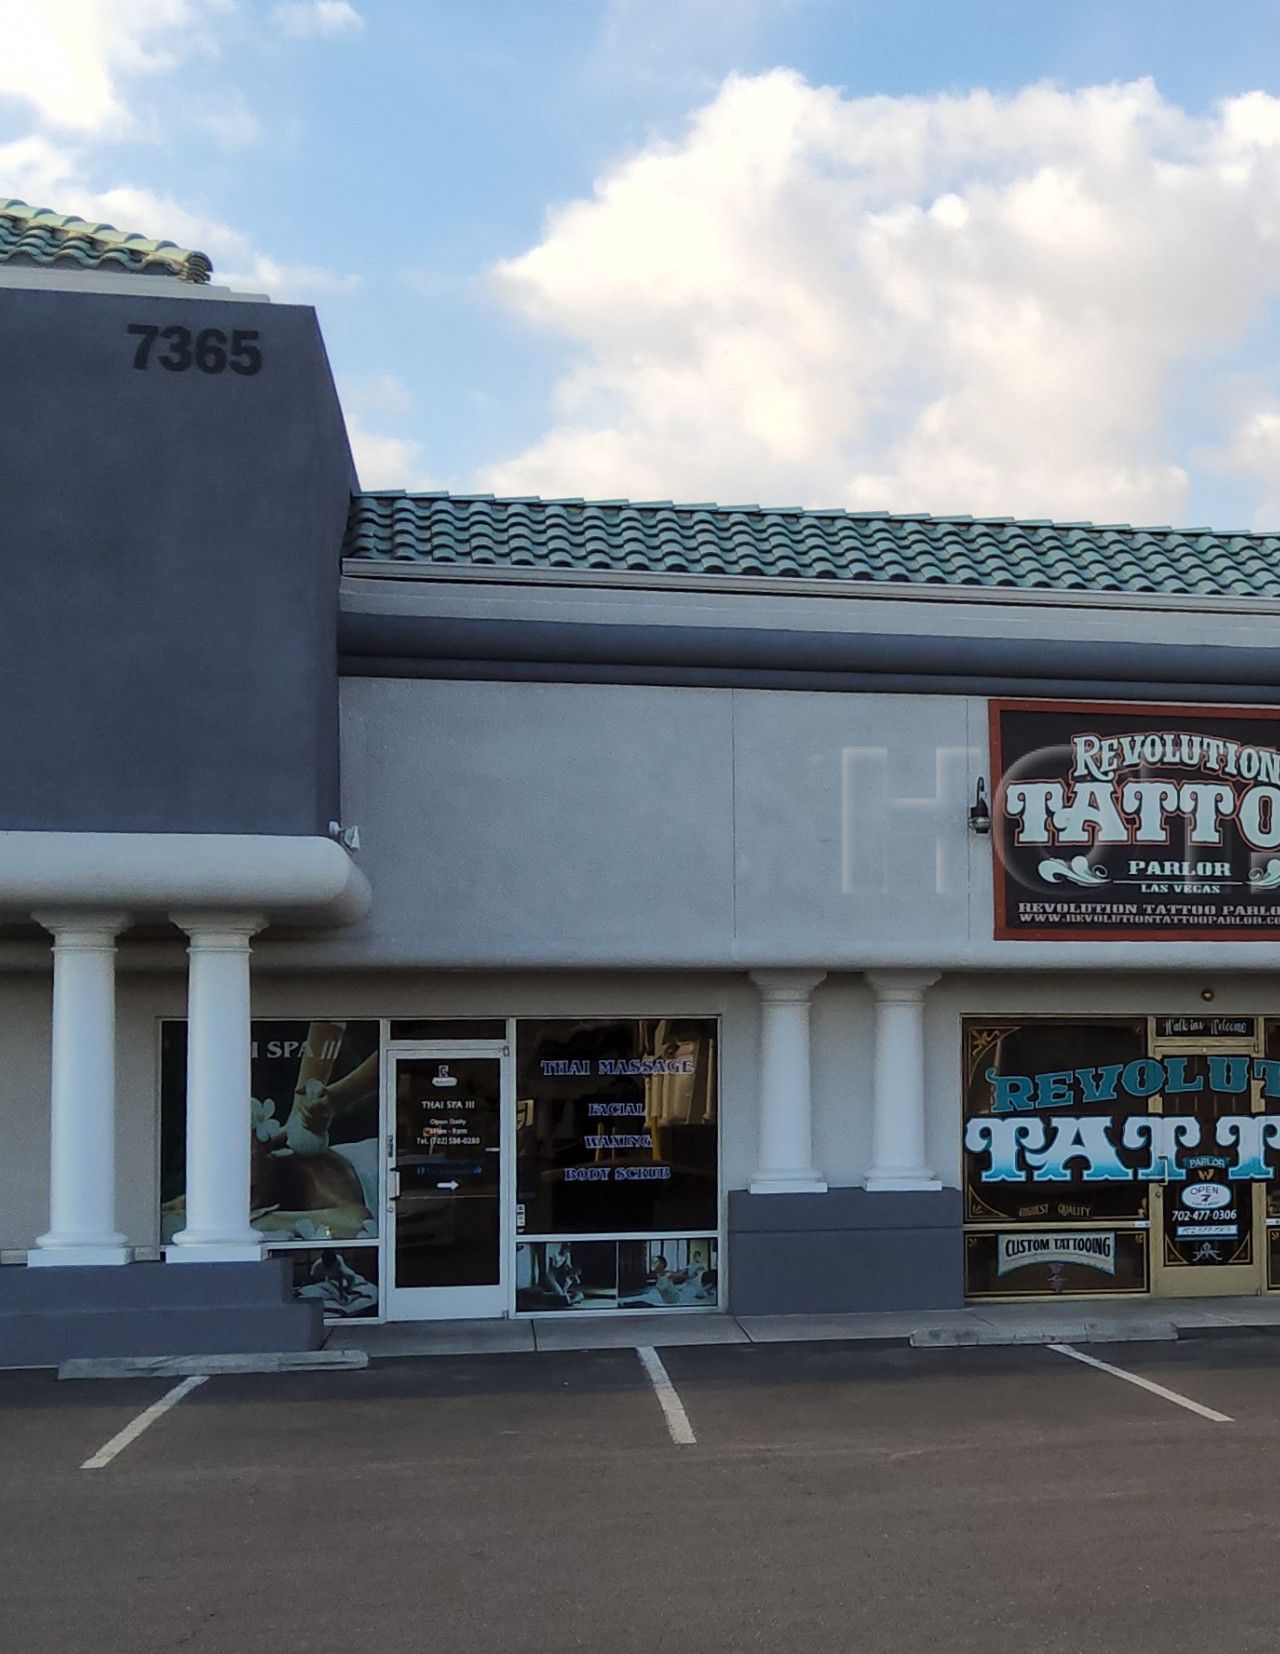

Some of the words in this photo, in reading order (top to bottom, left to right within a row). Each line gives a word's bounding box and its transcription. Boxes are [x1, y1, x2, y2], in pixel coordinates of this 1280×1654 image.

[127, 323, 263, 376] 7365
[1127, 859, 1232, 877] PARLOR
[1141, 884, 1169, 893] LAS
[1174, 883, 1221, 894] VEGAS
[1018, 902, 1138, 914] REVOLUTION
[1143, 904, 1216, 916] TATTOO
[540, 1060, 591, 1075] THAI
[598, 1059, 695, 1075] MASSAGE
[1189, 1158, 1225, 1169] PARLOR
[564, 1168, 611, 1181] BODY
[1190, 1186, 1219, 1195] OPEN
[1201, 1194, 1211, 1202] 7
[1005, 1239, 1050, 1258] CUSTOM
[1053, 1237, 1111, 1257] TATTOOING
